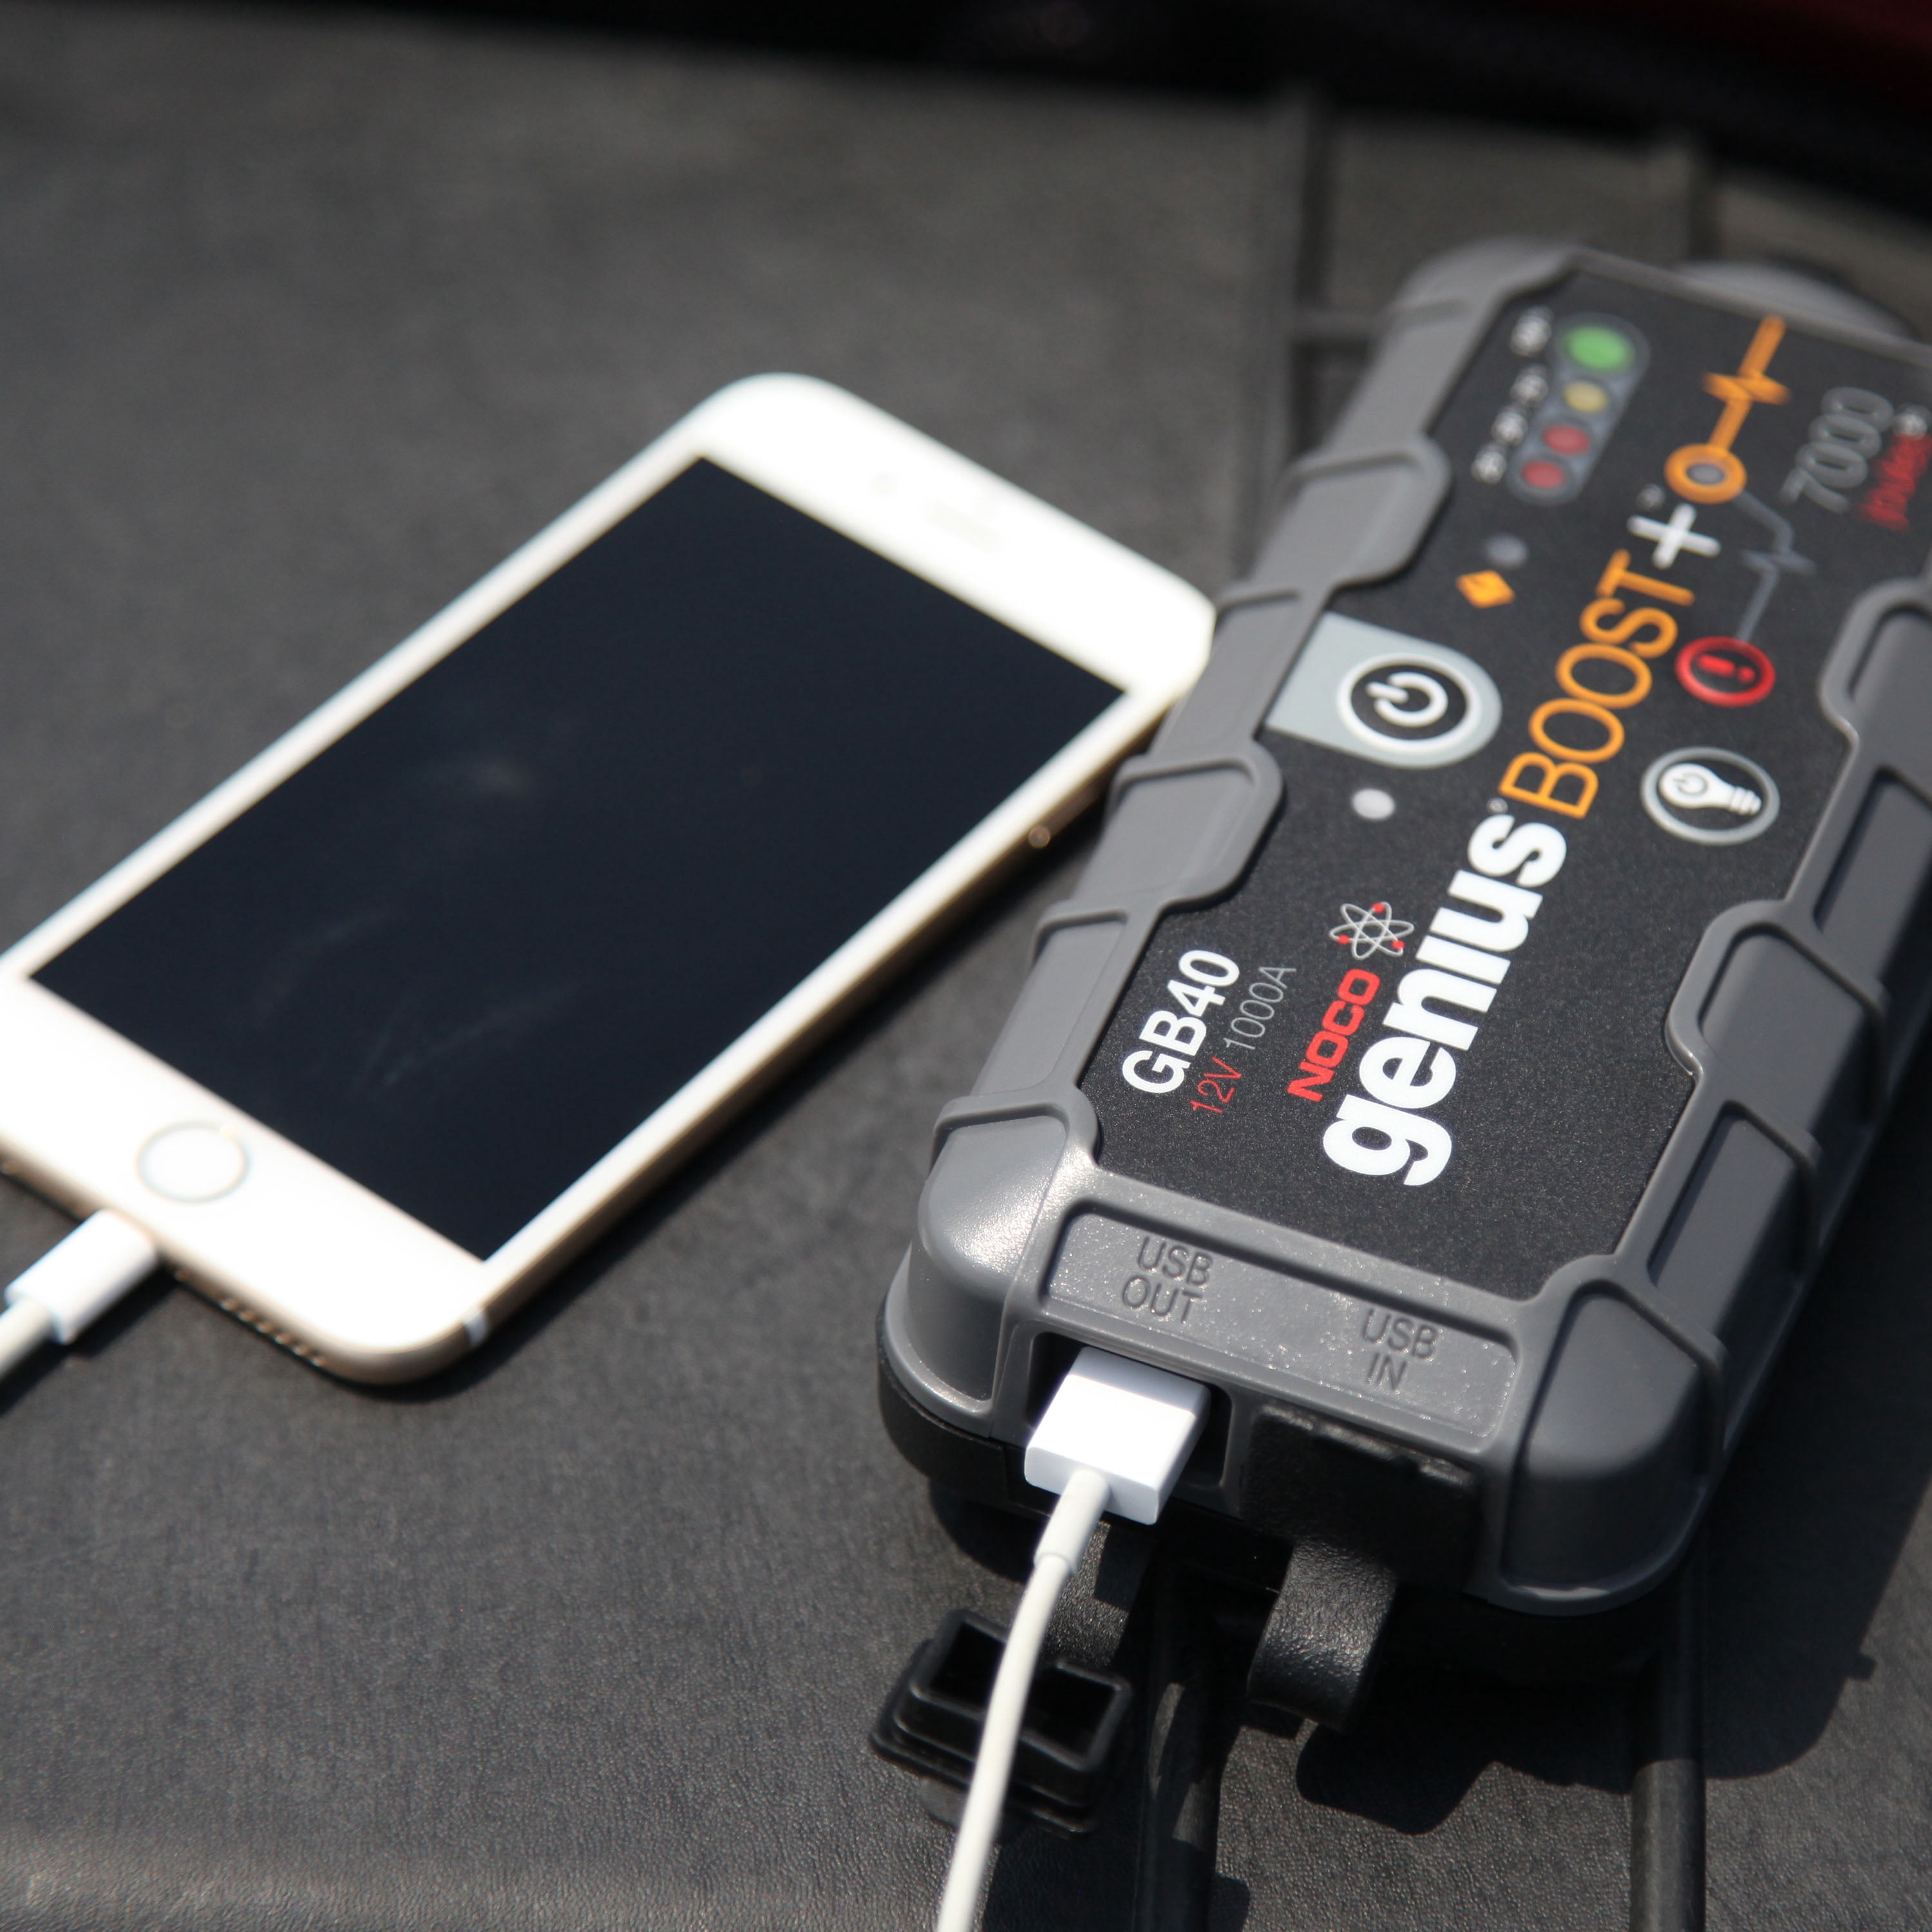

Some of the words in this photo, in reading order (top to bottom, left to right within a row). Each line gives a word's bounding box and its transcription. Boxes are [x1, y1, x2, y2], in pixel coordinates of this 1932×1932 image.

[1779, 386, 1895, 514] 7000
[1121, 949, 1240, 1095] GB40
[1189, 1056, 1242, 1114] 12V
[1222, 965, 1296, 1050] 1000A
[1287, 968, 1381, 1103] NOCO
[1322, 813, 1567, 1186] genius
[1121, 1274, 1203, 1325] OUT
[1137, 1236, 1214, 1287] USB
[1361, 1307, 1438, 1359] USB
[1367, 1352, 1408, 1390] IN
